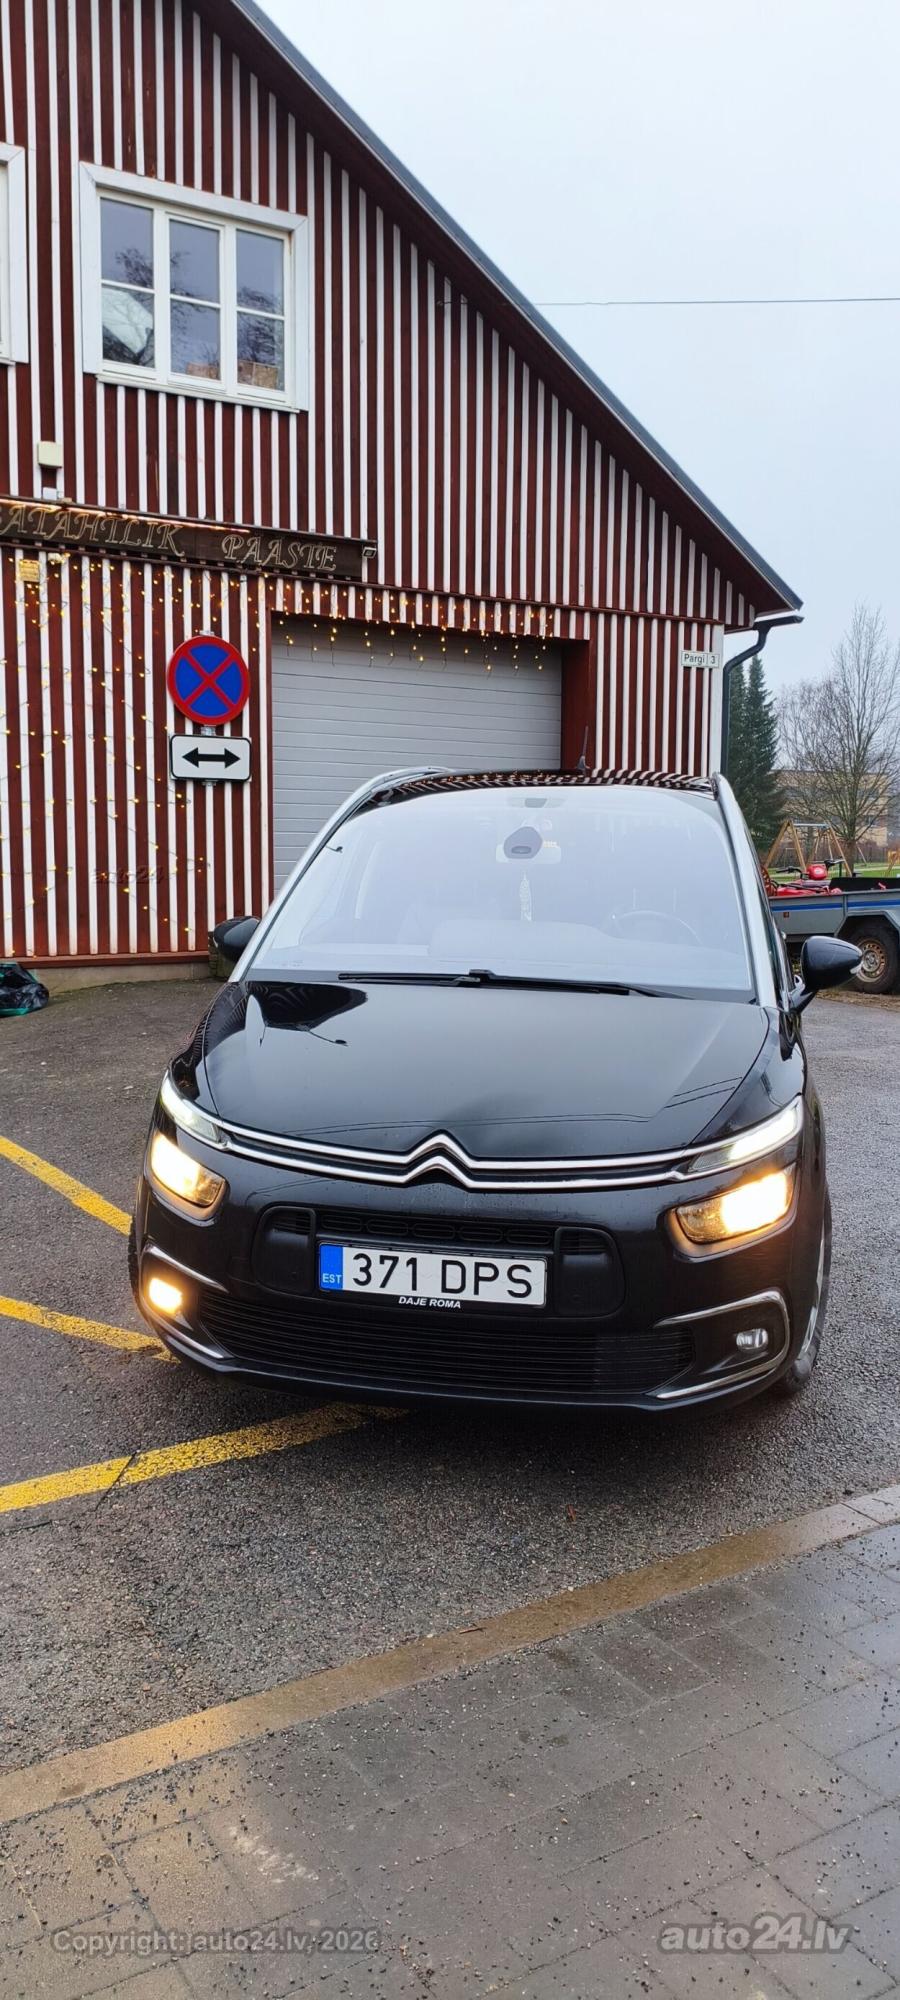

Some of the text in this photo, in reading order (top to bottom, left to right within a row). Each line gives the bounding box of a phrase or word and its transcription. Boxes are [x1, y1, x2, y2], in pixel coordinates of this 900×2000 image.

[0, 504, 185, 557] ATAHTLIK
[684, 653, 716, 665] Pargi 3
[322, 1273, 342, 1284] EST
[352, 1253, 532, 1299] 371 DPS
[398, 1296, 461, 1309] DAJE ROMA
